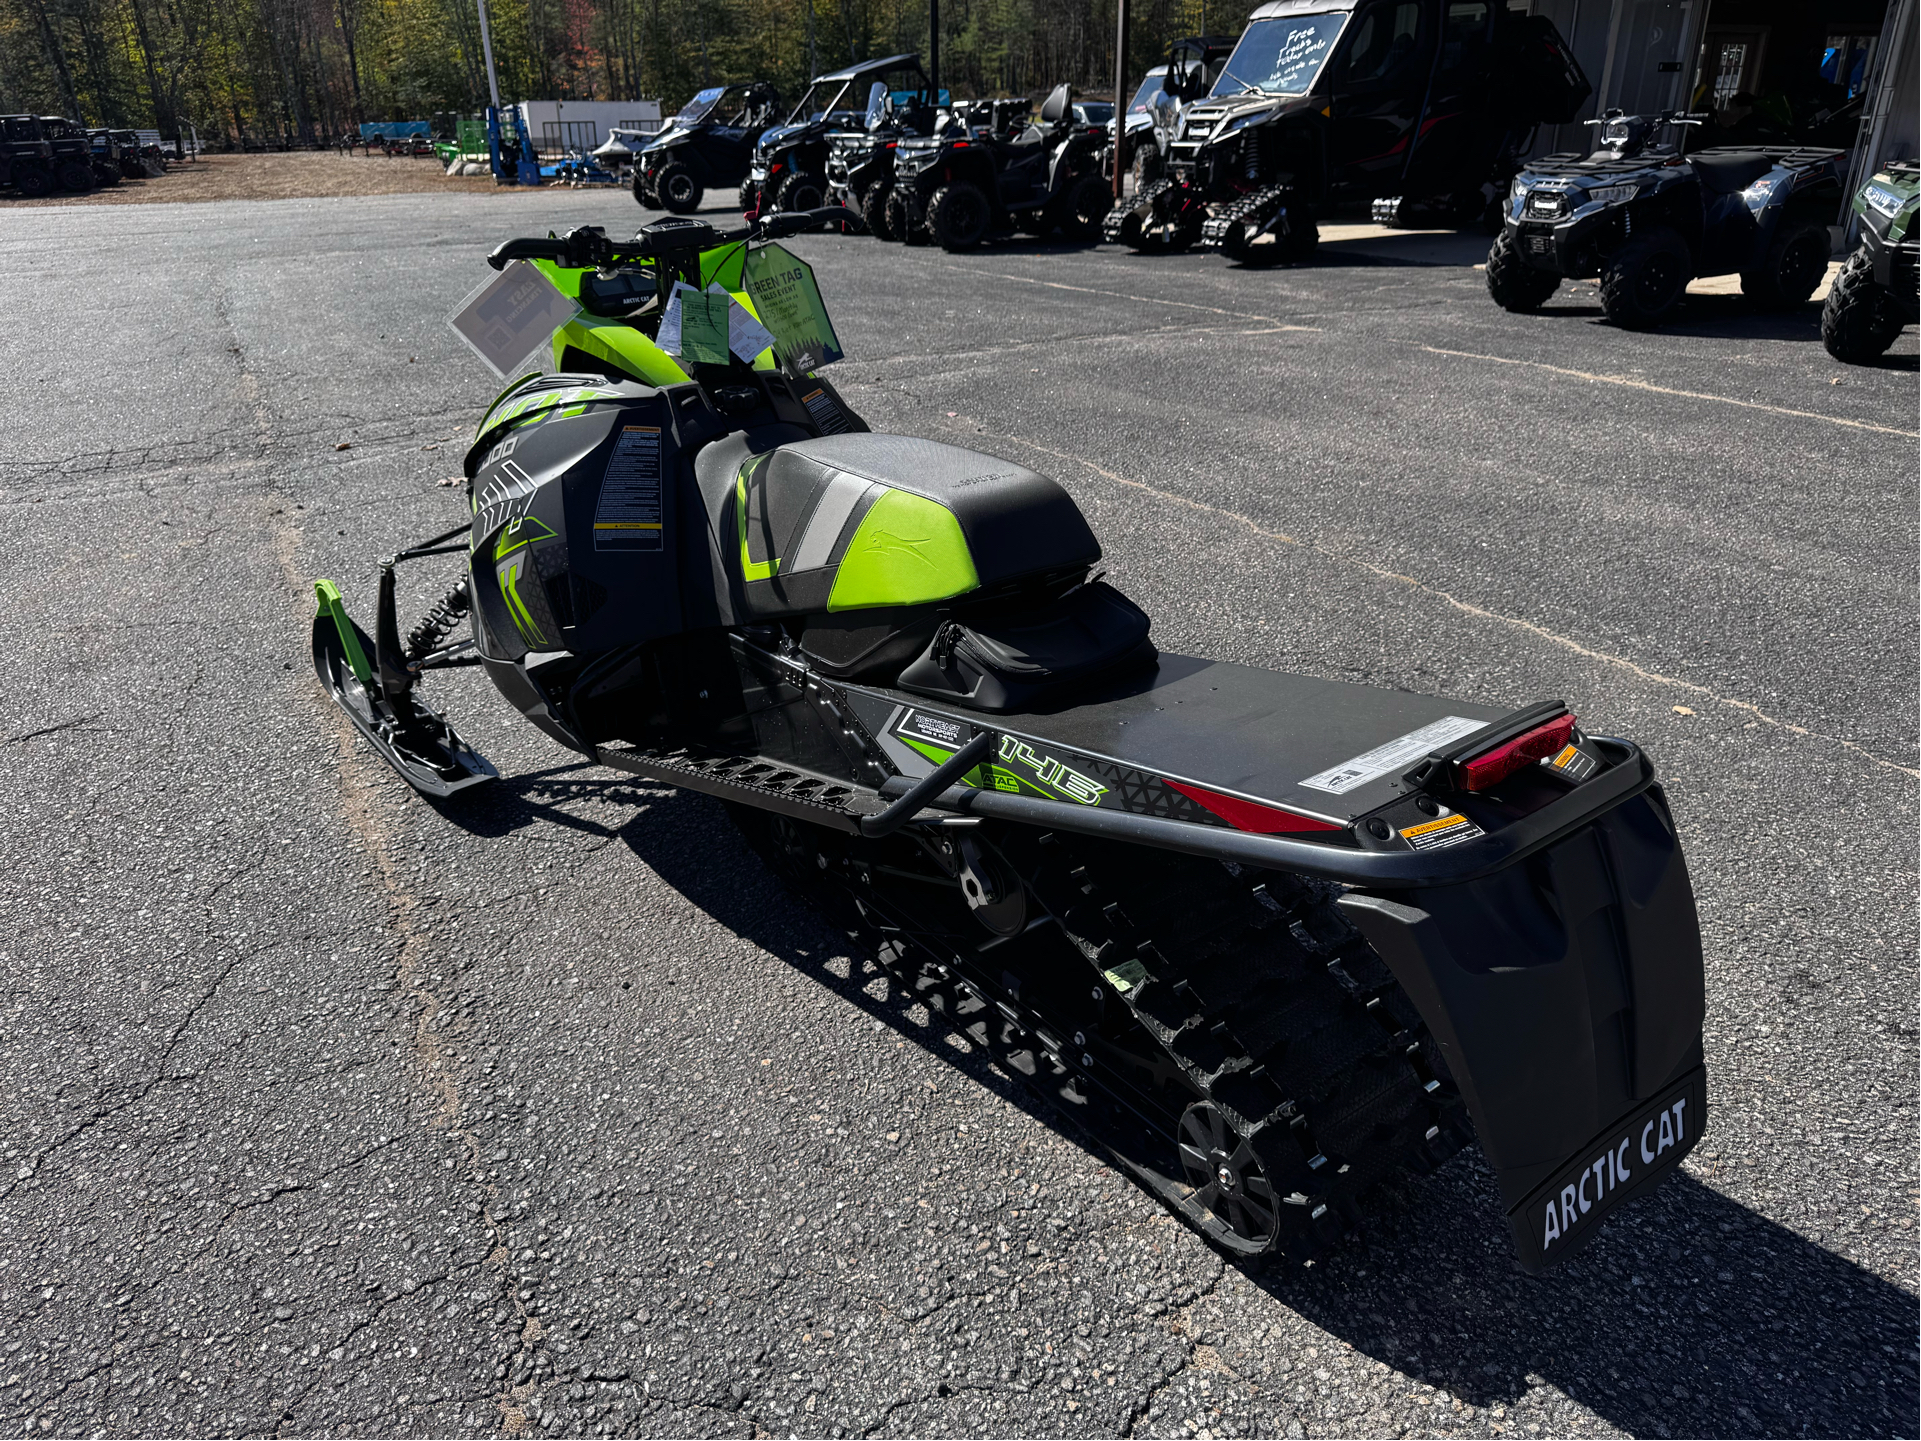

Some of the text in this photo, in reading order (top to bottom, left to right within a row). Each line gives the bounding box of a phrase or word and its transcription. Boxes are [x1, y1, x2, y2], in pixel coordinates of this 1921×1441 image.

[1286, 26, 1315, 48] Free
[749, 267, 803, 295] GREEN TAG
[623, 297, 640, 305] ARCTIC
[760, 283, 797, 302] SALES EVENT
[983, 773, 1018, 788] ATAC
[1543, 1097, 1686, 1251] ARCTIC CAT
